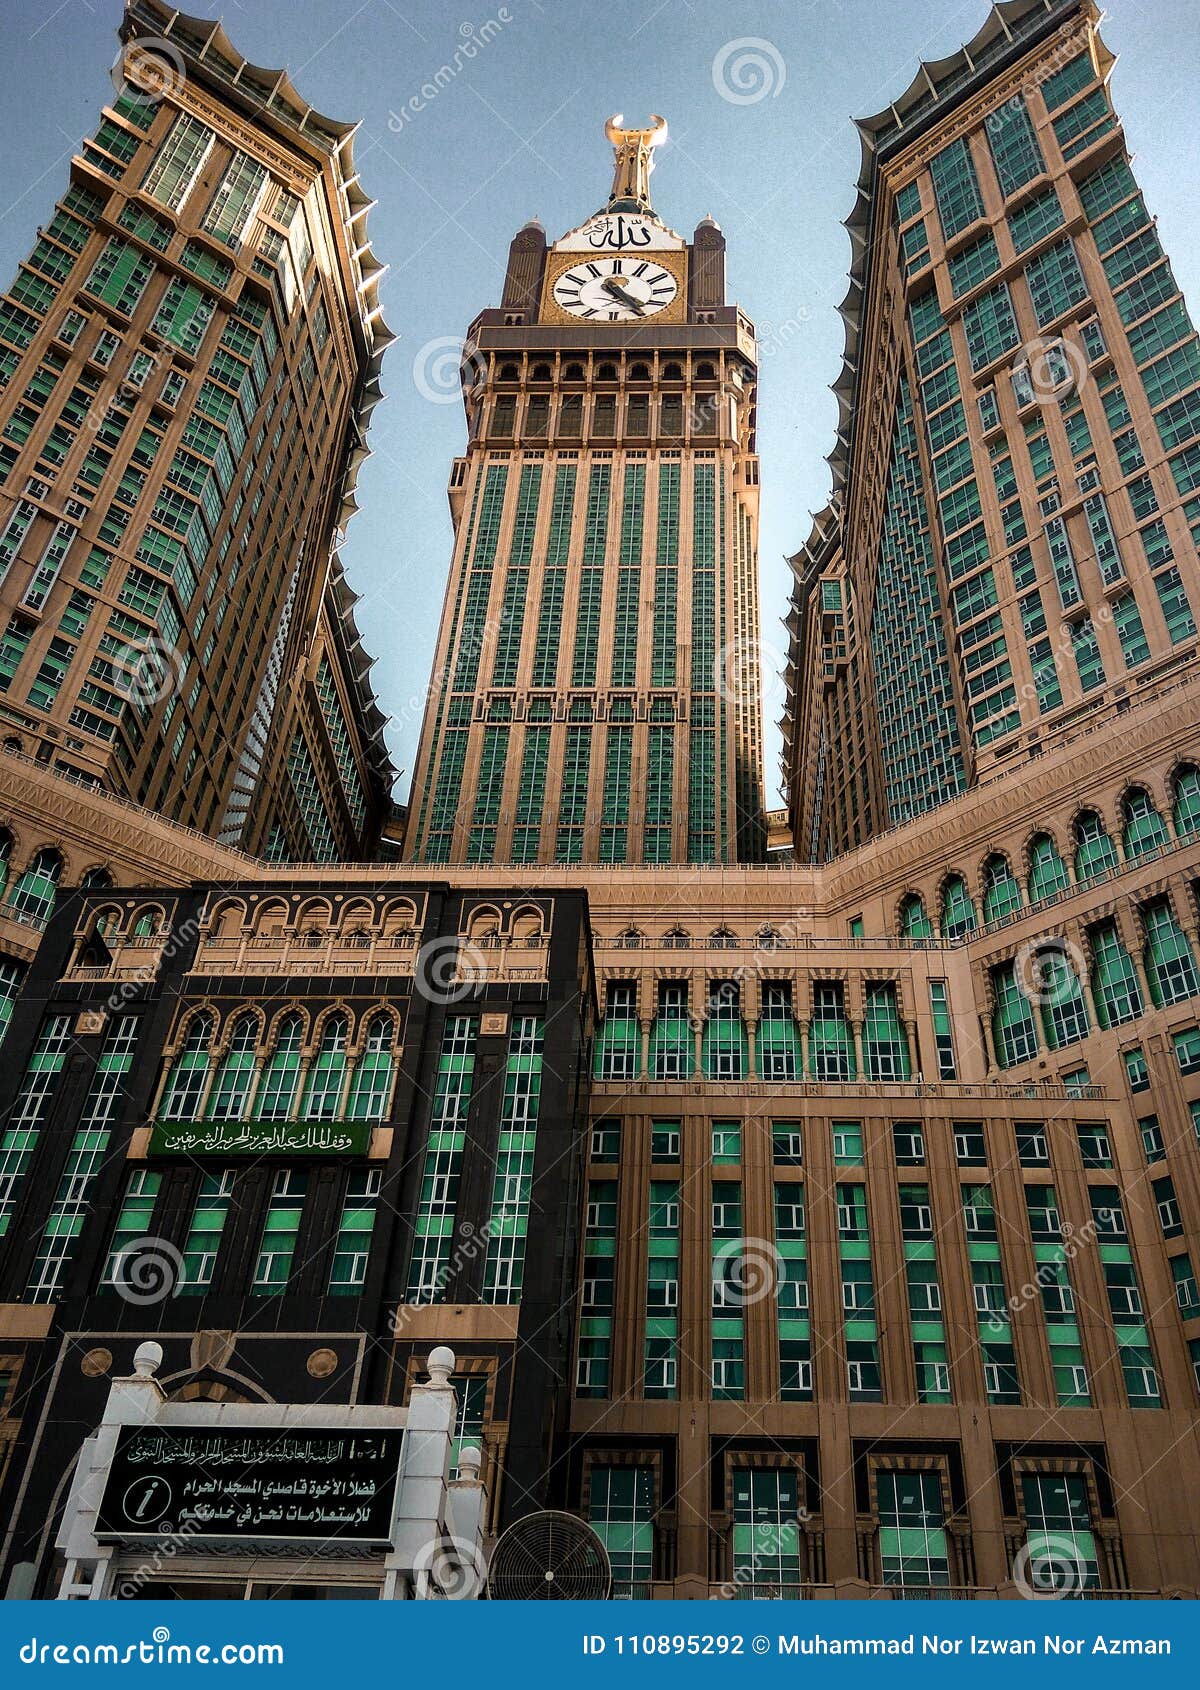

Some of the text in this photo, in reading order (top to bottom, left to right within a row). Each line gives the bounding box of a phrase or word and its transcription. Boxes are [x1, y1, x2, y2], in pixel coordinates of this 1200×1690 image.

[165, 1126, 224, 1151] الشريفين
[205, 1126, 251, 1151] للحرمين
[292, 1127, 331, 1149] الملك
[319, 1134, 353, 1151] وقف
[183, 1479, 222, 1497] الحرام
[223, 1478, 262, 1497] المسجد
[262, 1478, 308, 1500] قاصدي
[178, 1503, 235, 1522] خدمتكم
[236, 1503, 252, 1527] في
[252, 1505, 283, 1524] نحن
